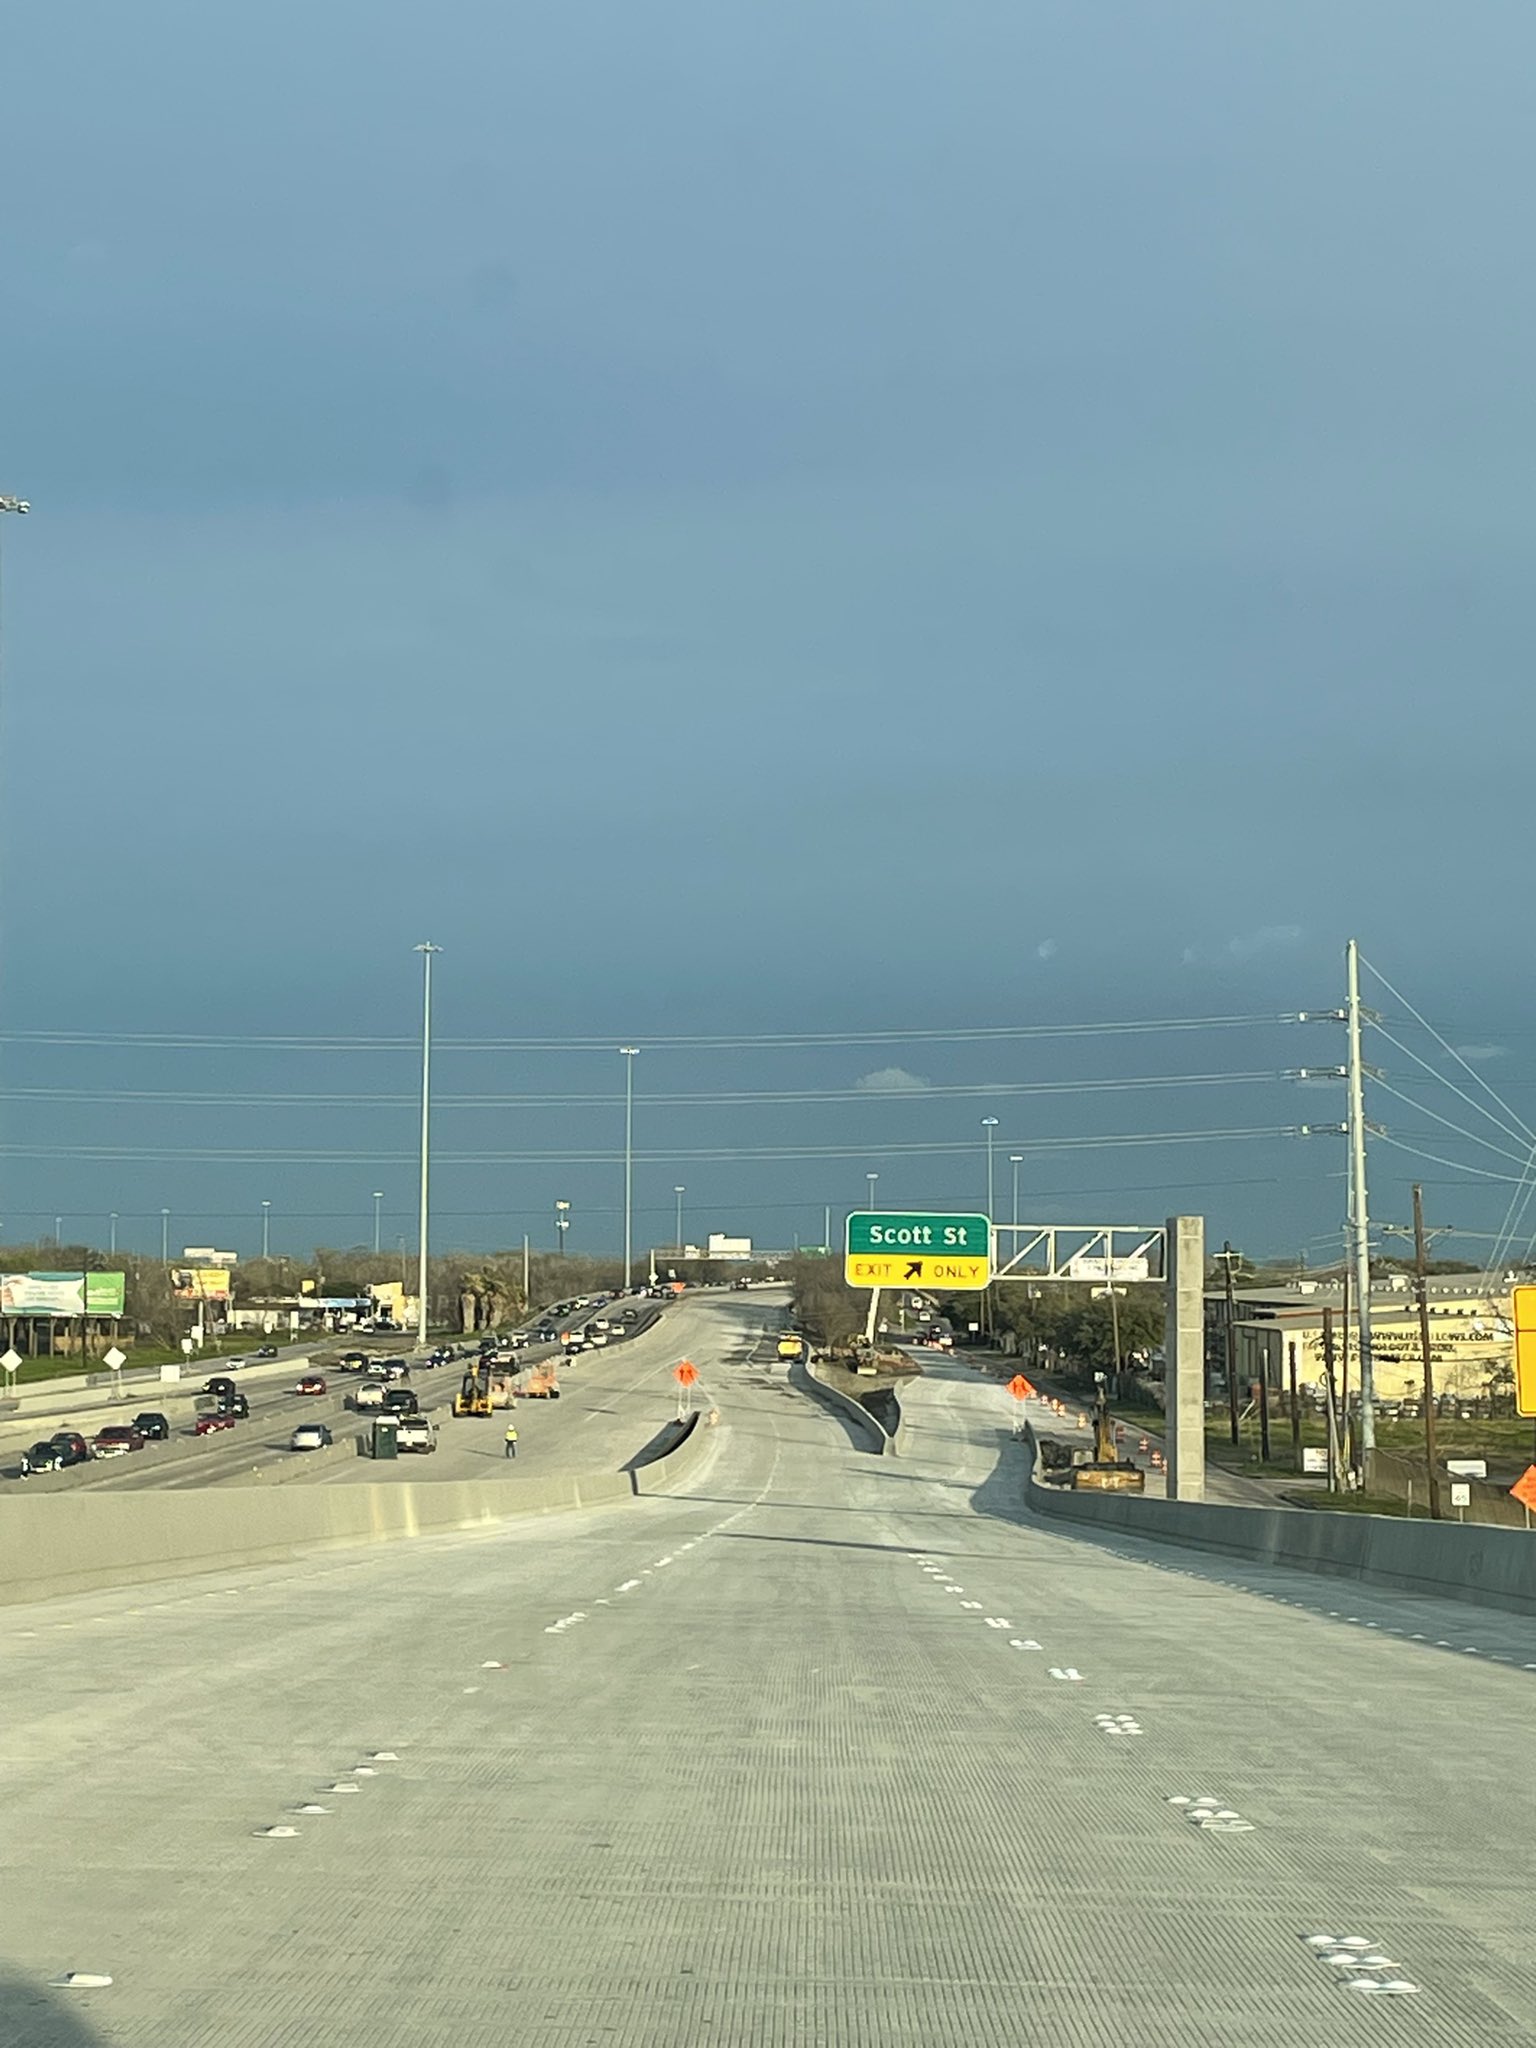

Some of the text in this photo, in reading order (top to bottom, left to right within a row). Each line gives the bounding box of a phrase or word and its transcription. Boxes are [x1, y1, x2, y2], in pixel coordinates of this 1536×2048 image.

[869, 1225, 968, 1246] Scott St
[855, 1263, 980, 1278] EXIT ONLY
